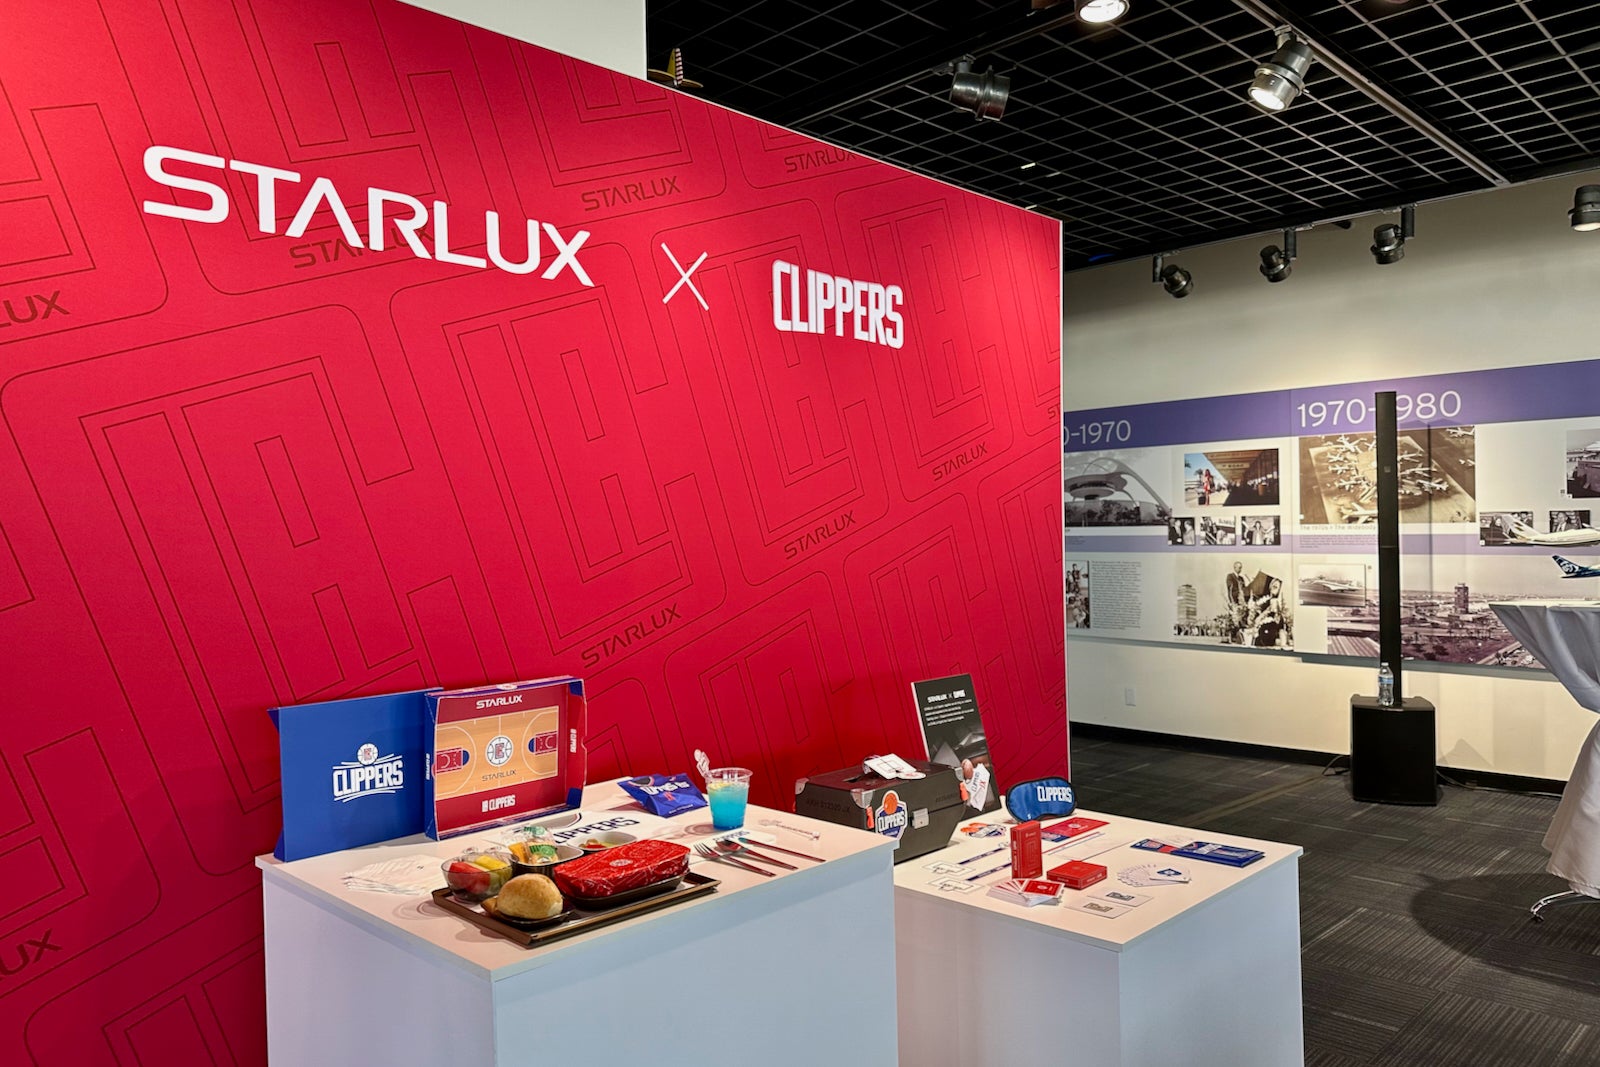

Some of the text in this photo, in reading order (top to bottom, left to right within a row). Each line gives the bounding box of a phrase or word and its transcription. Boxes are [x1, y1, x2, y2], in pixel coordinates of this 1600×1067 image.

[581, 176, 681, 211] STARLUX
[143, 145, 595, 287] STARLUX
[772, 259, 905, 350] CLIPPERS
[0, 290, 70, 327] UX
[1297, 390, 1461, 427] 1970-980
[931, 442, 989, 481] STARLUX
[783, 510, 857, 560] STARLUX
[580, 603, 682, 669] STARLUX
[476, 695, 523, 709] STARLUX
[332, 760, 404, 797] CLIPPERS
[482, 769, 517, 781] STARLUX
[489, 795, 516, 811] CLIPPERS
[1036, 785, 1073, 803] CLIPPERS
[877, 810, 905, 832] CLIPPERS
